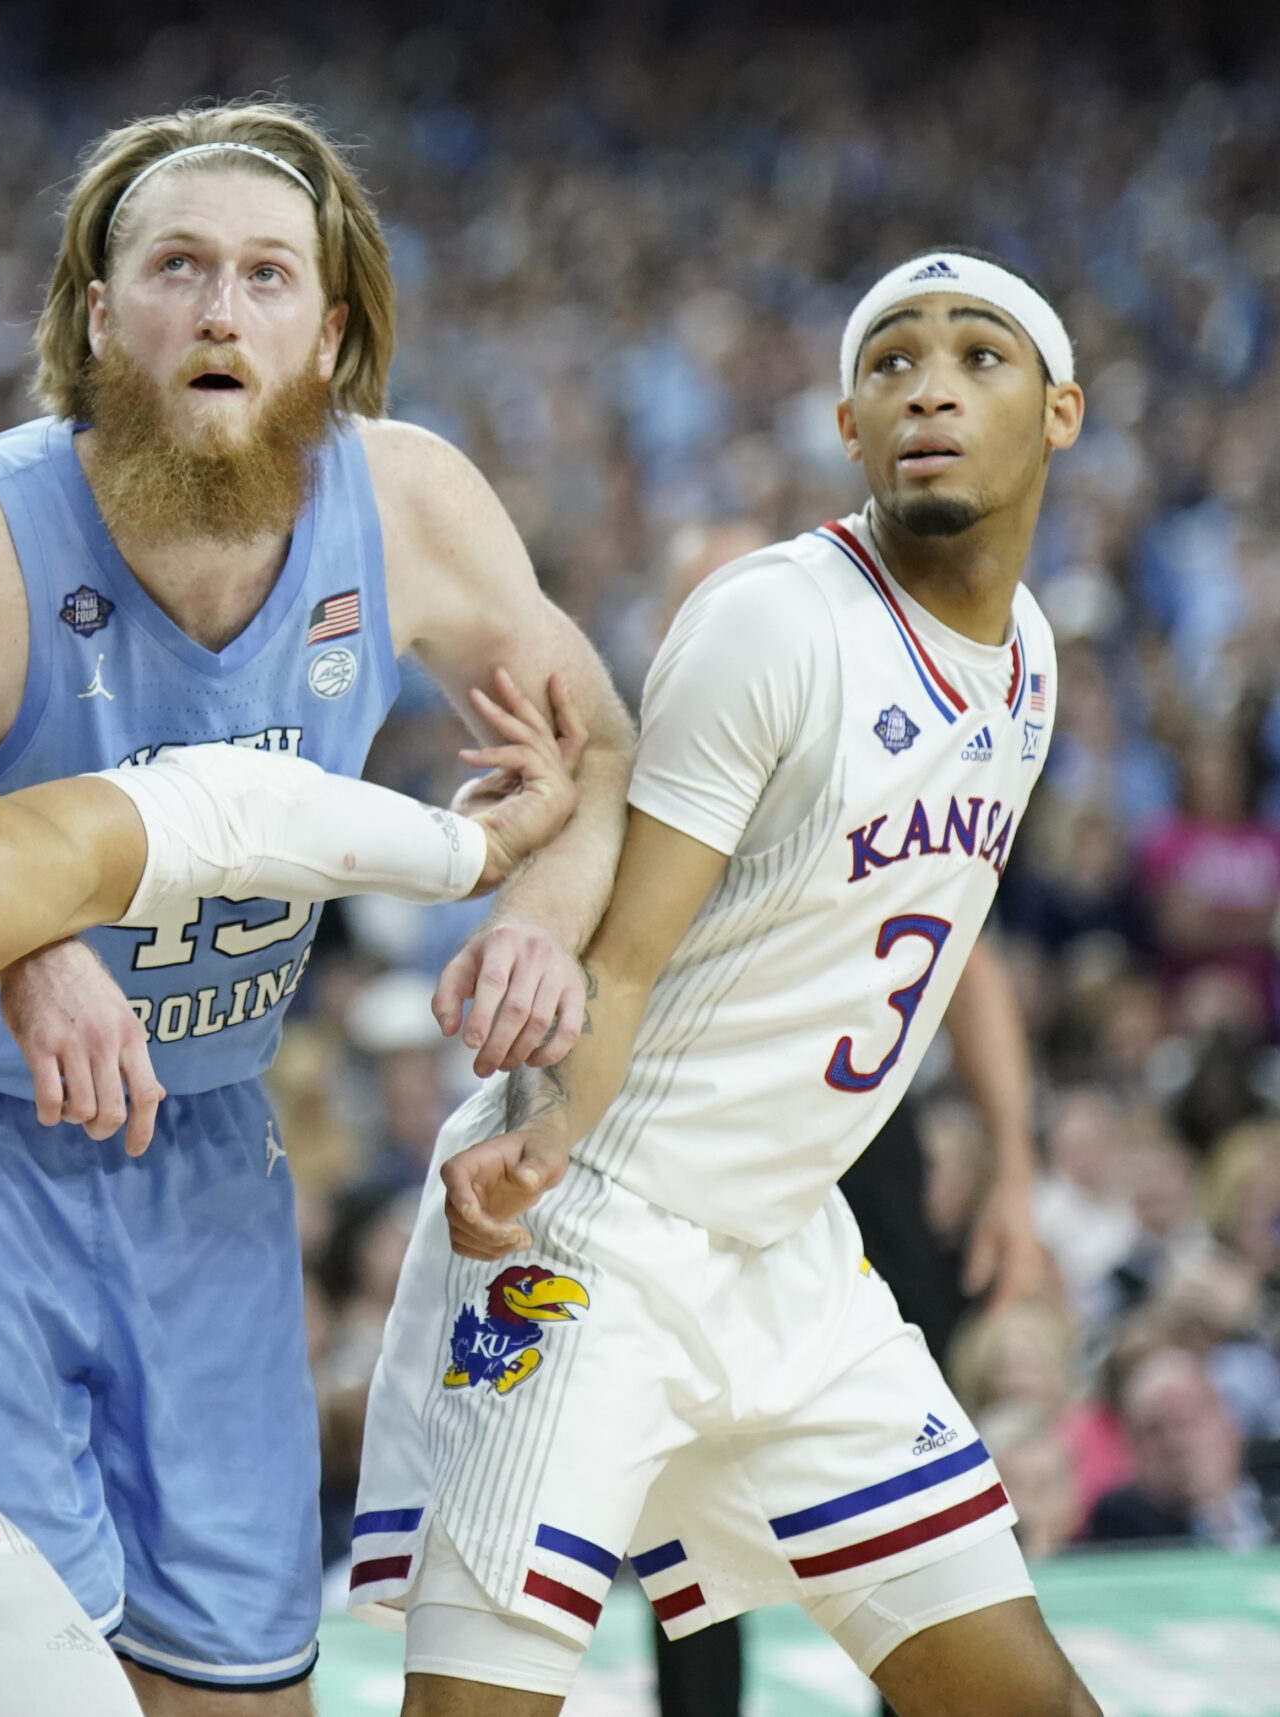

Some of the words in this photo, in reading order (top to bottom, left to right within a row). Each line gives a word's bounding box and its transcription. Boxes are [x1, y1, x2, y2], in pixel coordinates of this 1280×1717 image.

[846, 795, 1013, 884] KANSA
[824, 914, 952, 1094] 3
[470, 1331, 511, 1359] KU
[912, 1429, 958, 1456] adidas
